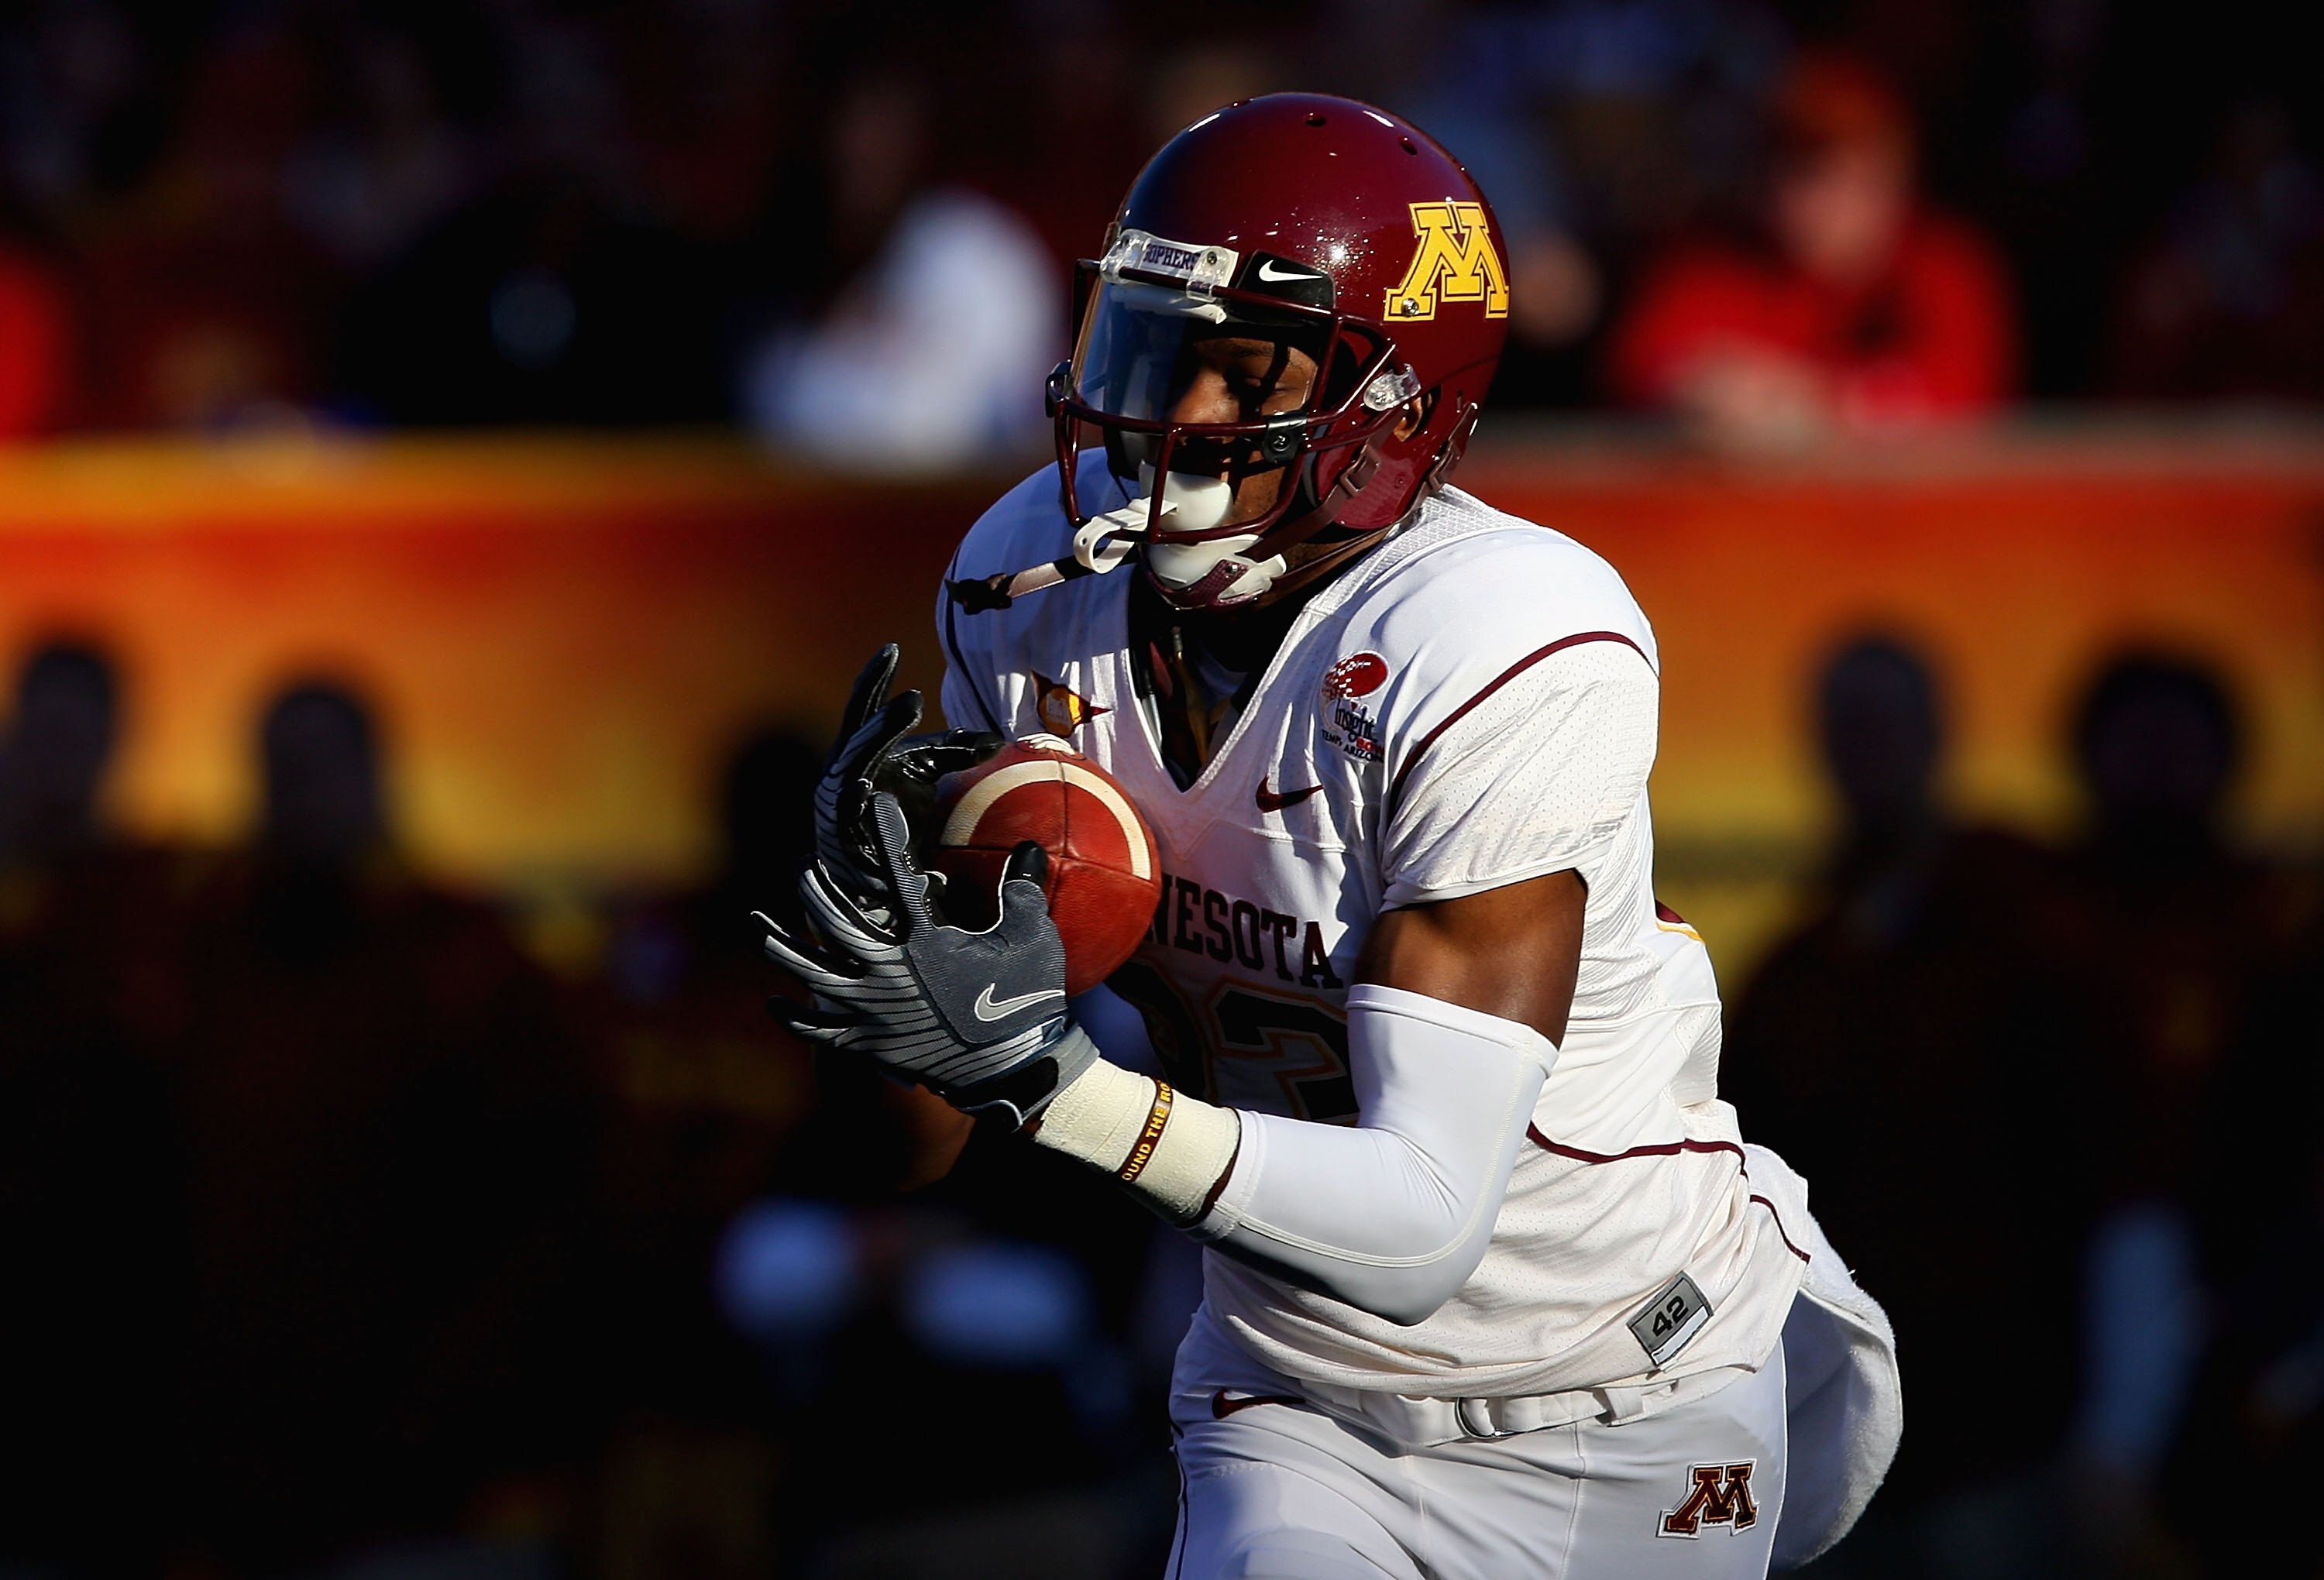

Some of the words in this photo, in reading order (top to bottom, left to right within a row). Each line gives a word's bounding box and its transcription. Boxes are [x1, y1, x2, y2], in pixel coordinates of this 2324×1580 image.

[1384, 201, 1509, 321] M
[1146, 1107, 1168, 1138] THE
[1652, 1295, 1689, 1337] 42
[1664, 1463, 1758, 1535] M
